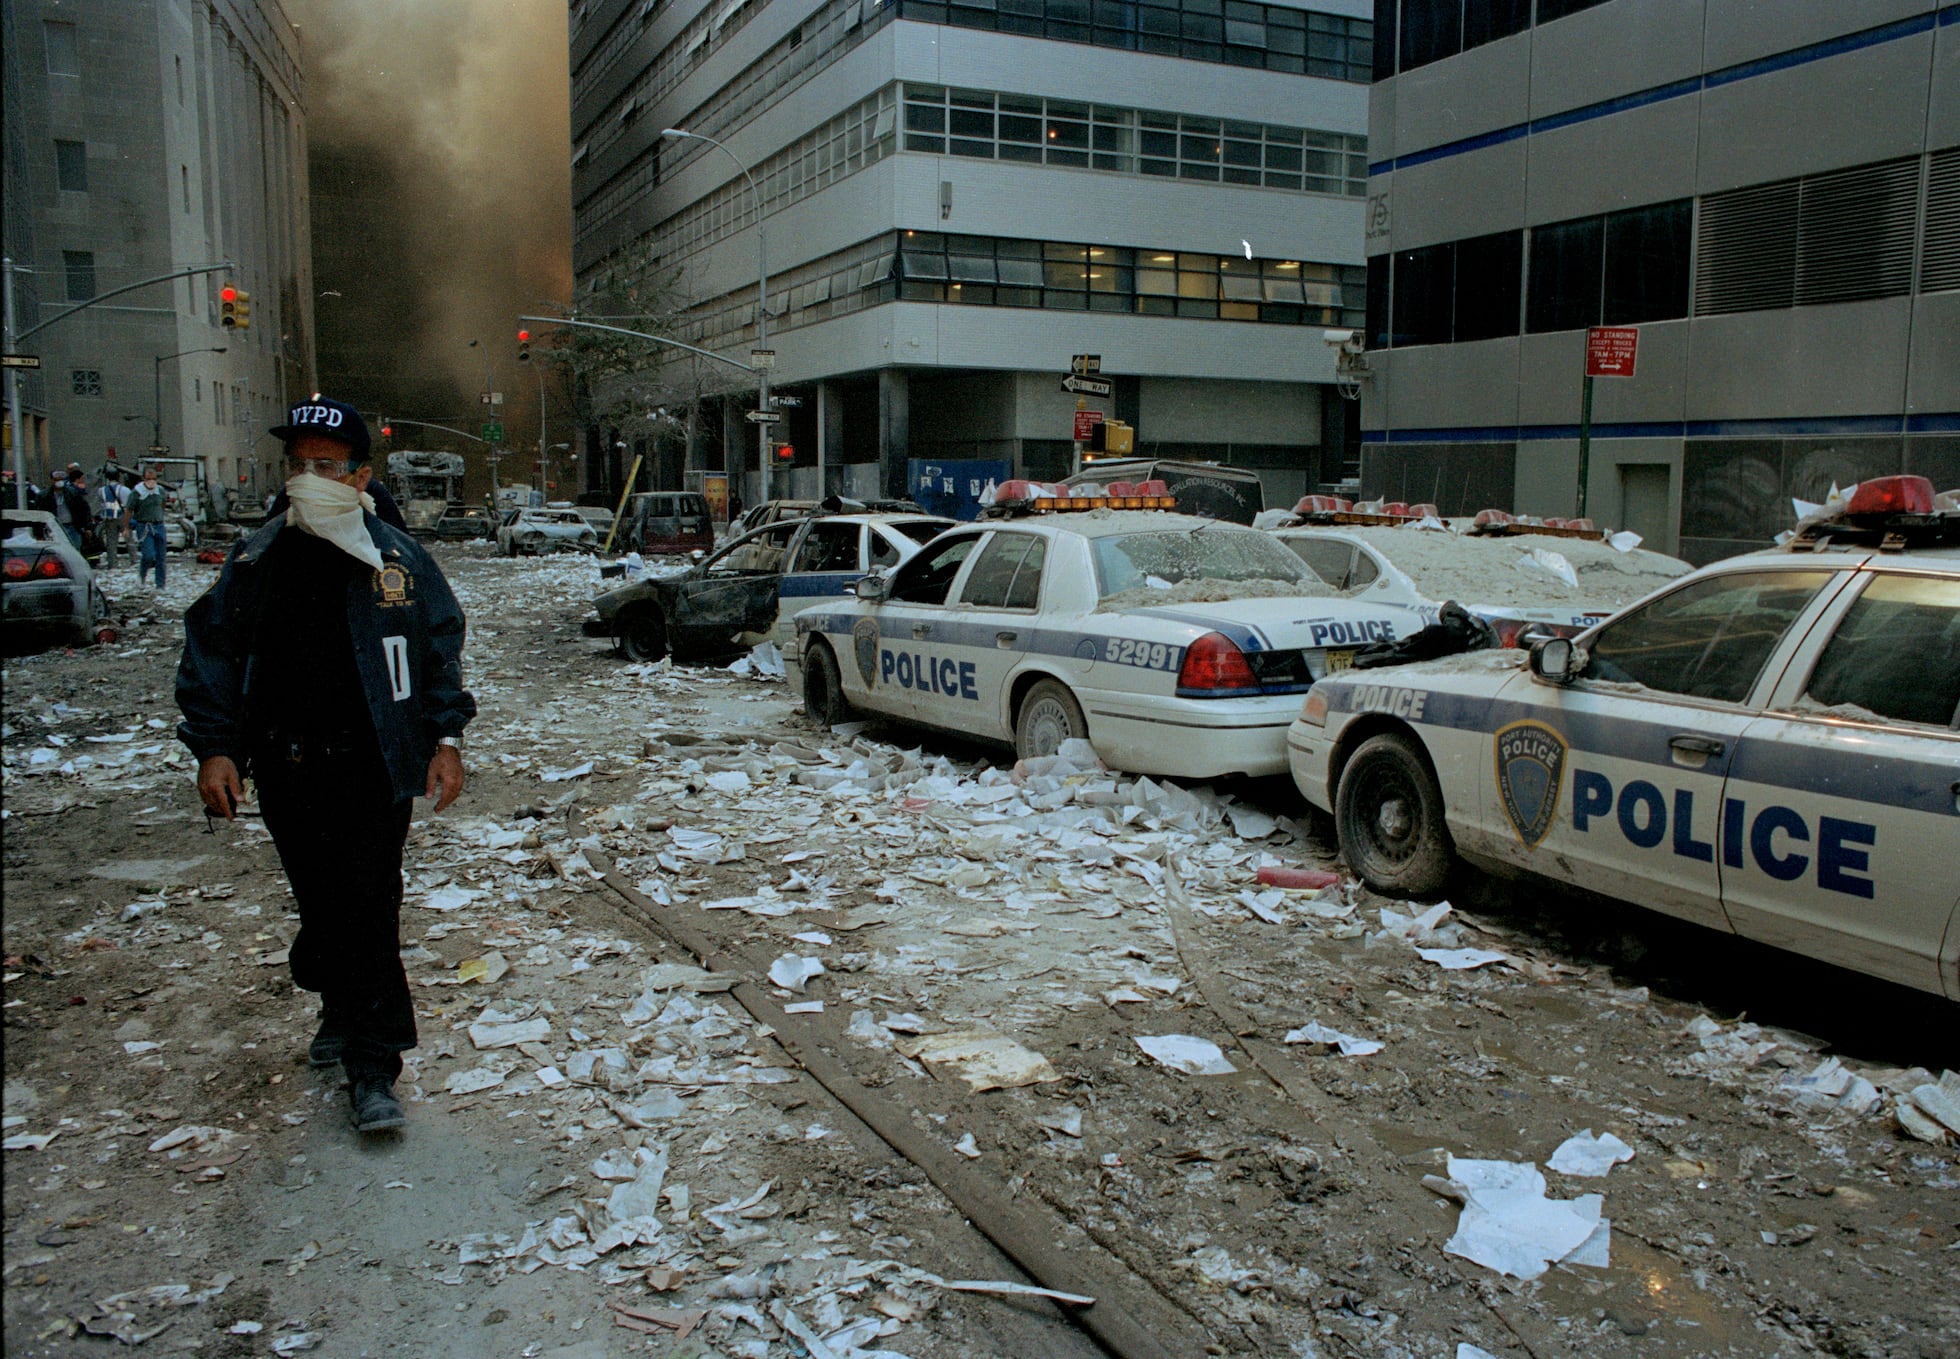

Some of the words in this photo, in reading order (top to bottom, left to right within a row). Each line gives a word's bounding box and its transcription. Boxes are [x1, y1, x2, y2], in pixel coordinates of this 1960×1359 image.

[1367, 192, 1389, 229] 75
[1615, 351, 1631, 359] 7PM
[1068, 379, 1084, 389] ONE
[1092, 383, 1107, 392] WAY
[292, 406, 343, 427] NYPD
[1309, 620, 1396, 647] POLICE
[1105, 638, 1181, 671] 52991
[881, 649, 979, 701] POLICE
[1351, 684, 1428, 720] POLICE
[1502, 739, 1558, 769] POLICE
[1572, 768, 1876, 900] POLICE
